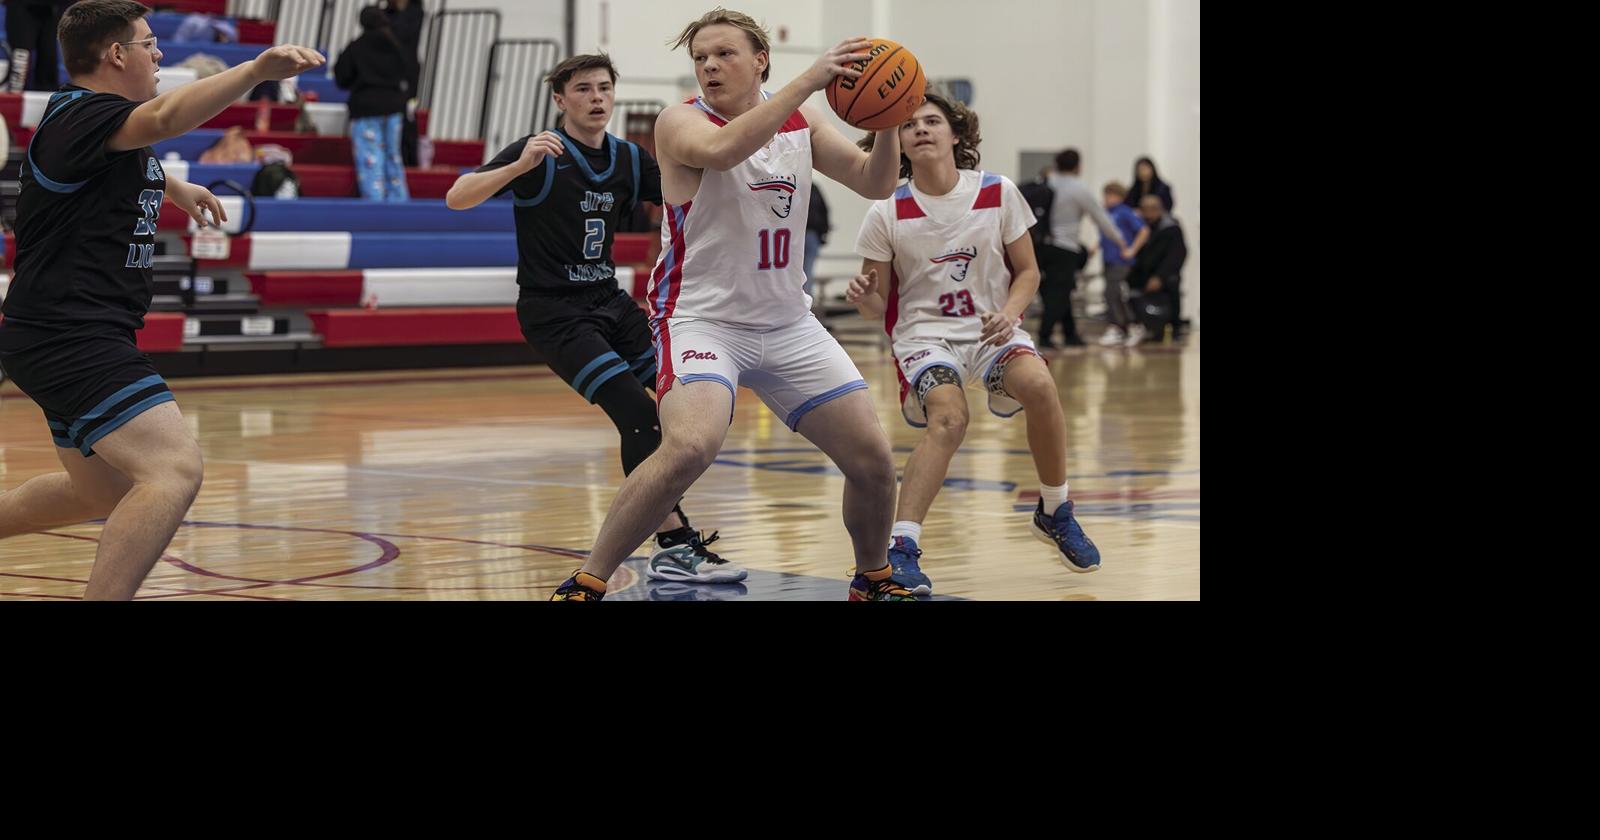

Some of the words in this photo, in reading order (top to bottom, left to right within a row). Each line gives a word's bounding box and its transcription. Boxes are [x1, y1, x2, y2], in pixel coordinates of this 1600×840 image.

[877, 65, 905, 99] EVO
[580, 190, 615, 212] JP2
[582, 218, 606, 259] 2
[757, 227, 791, 270] 10
[939, 289, 976, 318] 23
[681, 349, 718, 364] Pats
